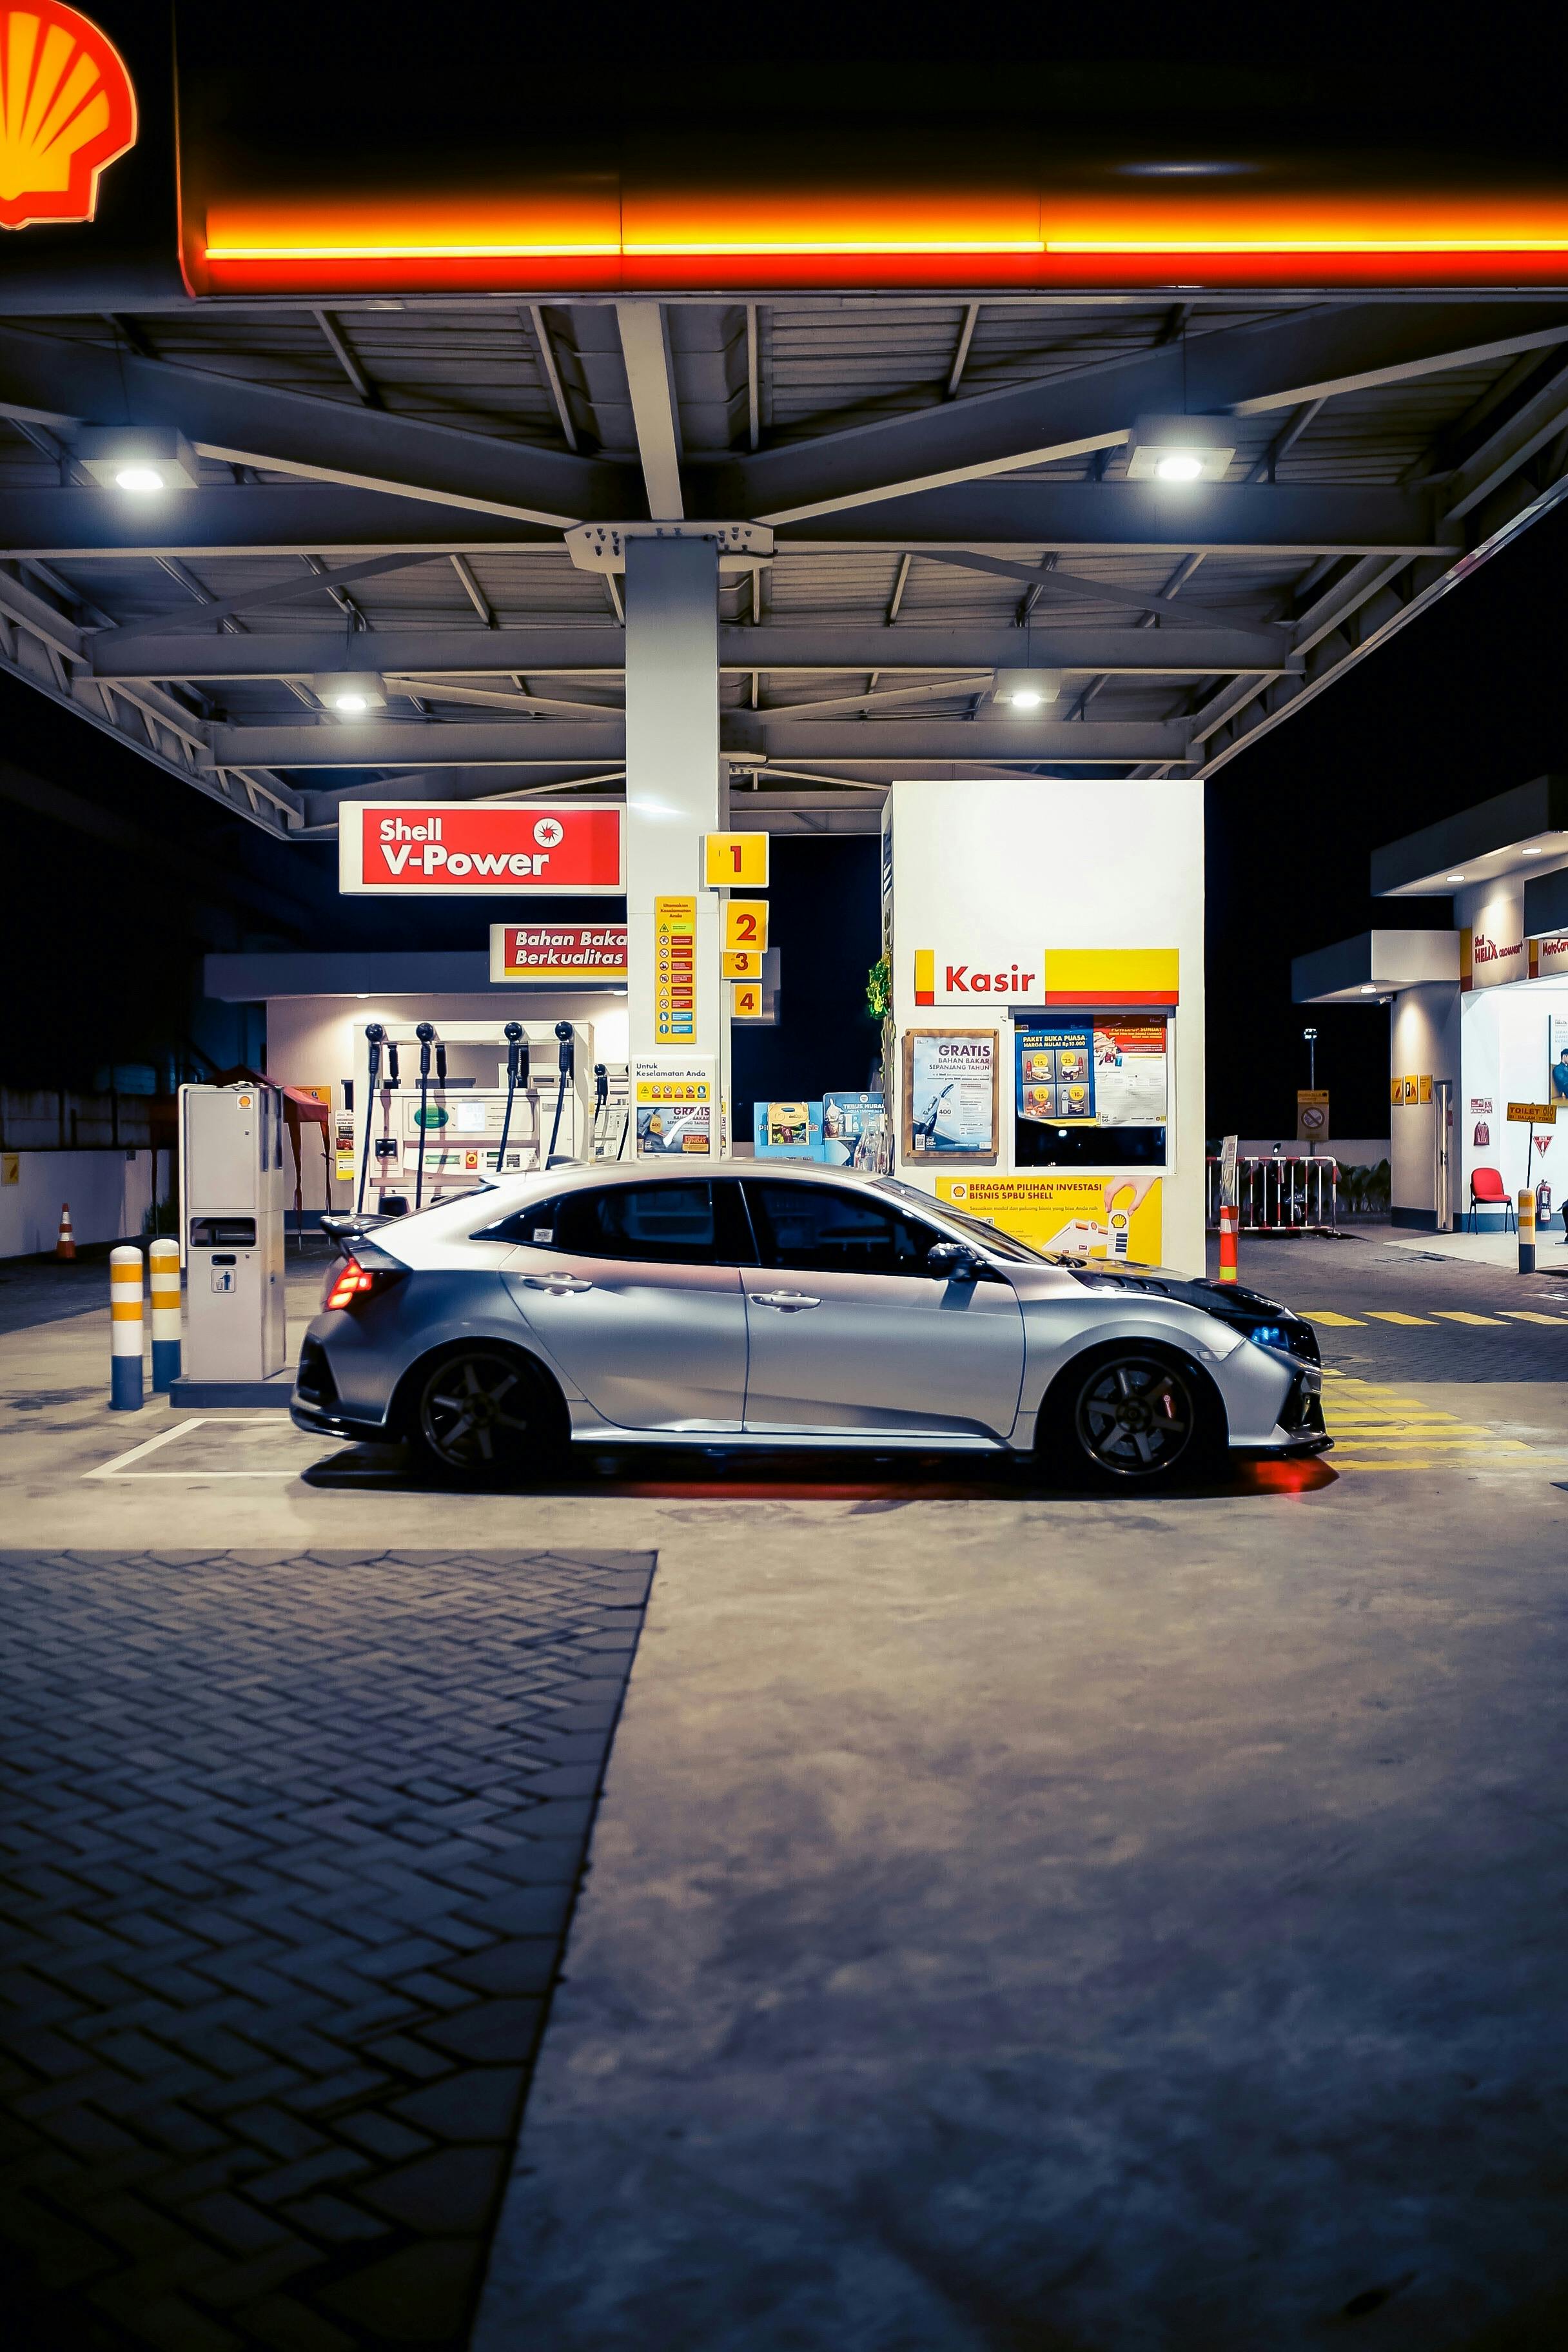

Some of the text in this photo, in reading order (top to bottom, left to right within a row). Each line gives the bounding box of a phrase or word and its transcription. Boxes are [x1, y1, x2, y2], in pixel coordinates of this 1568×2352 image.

[379, 817, 442, 841] Shell
[379, 843, 549, 876] V-Power
[730, 845, 741, 872] 1
[736, 914, 757, 941] 2
[515, 930, 627, 946] Bahan Baka
[1542, 938, 1568, 957] MotoCar
[515, 948, 623, 965] Berkualitas
[1475, 939, 1498, 964] HELIX
[734, 953, 749, 971] 3
[946, 964, 1035, 992] Kasir
[740, 993, 754, 1010] 4
[938, 1044, 990, 1057] GRATIS
[1509, 1106, 1540, 1115] TOILET
